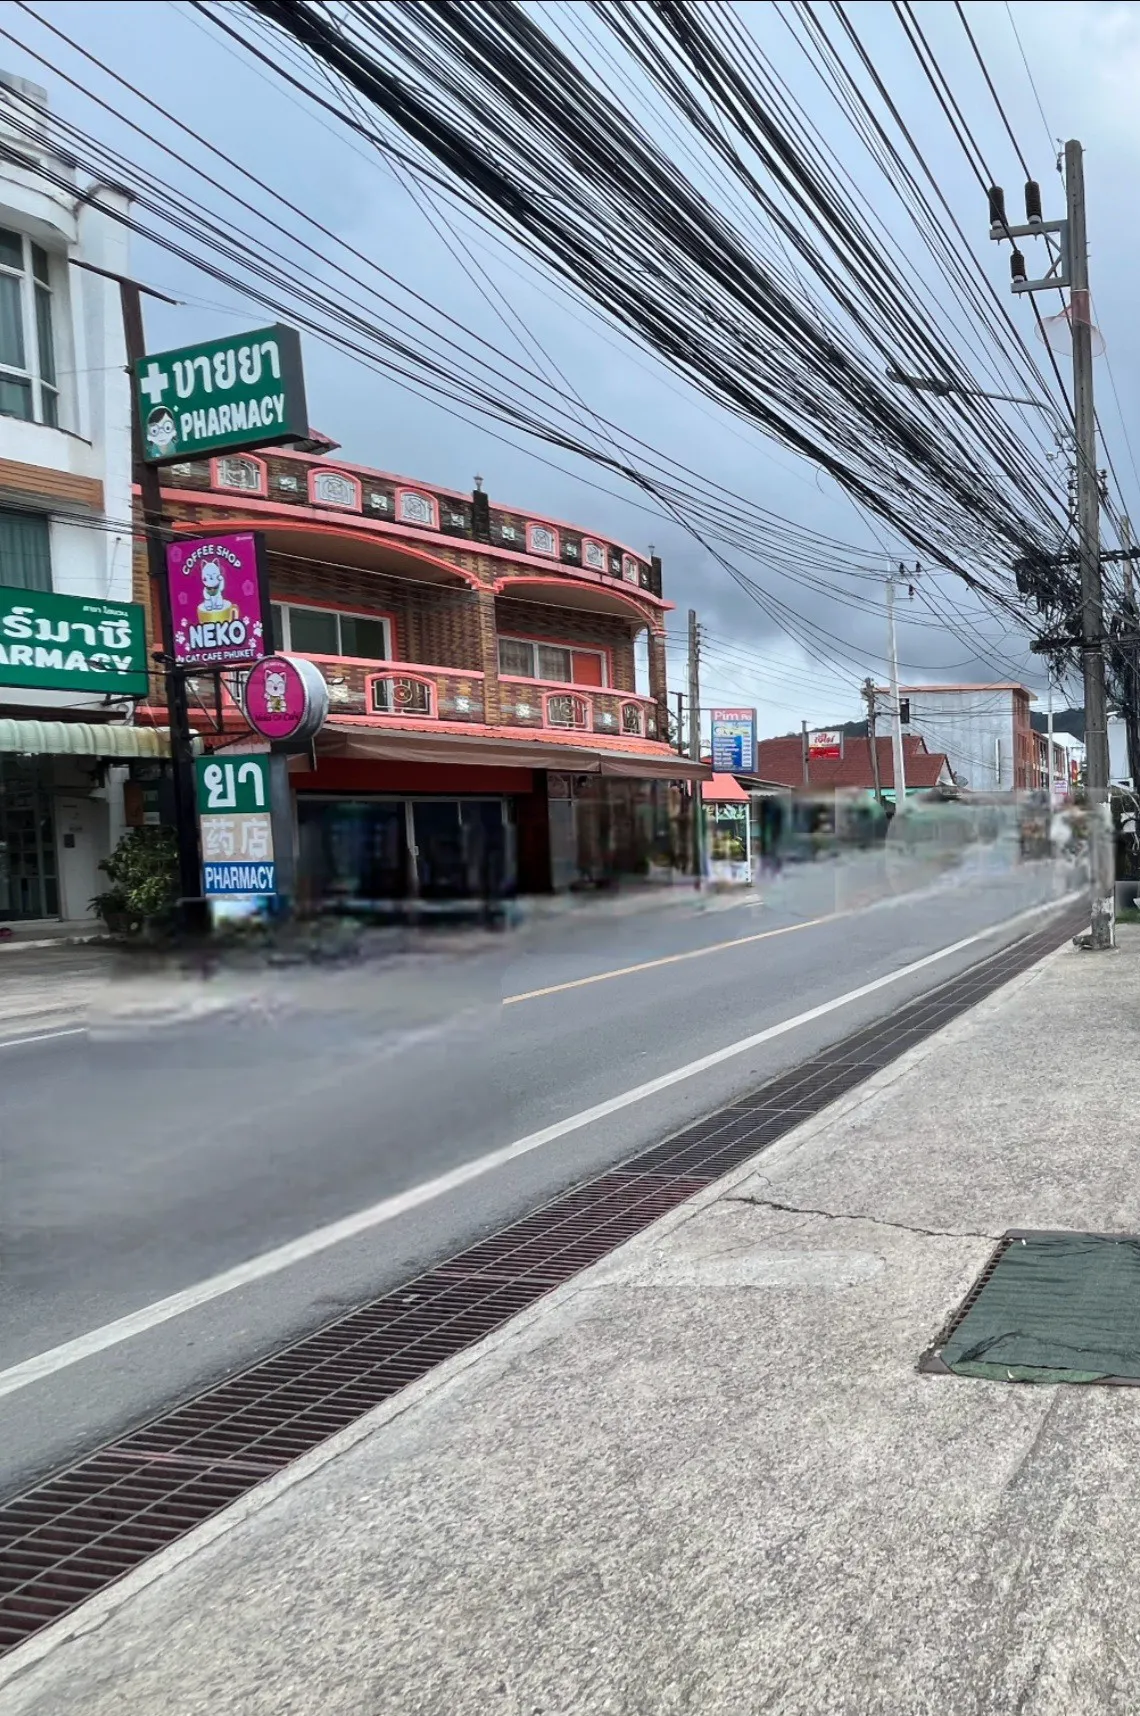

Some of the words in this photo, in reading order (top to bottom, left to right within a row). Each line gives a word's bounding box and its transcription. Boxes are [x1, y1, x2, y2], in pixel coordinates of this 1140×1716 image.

[180, 393, 285, 442] PHARMACY
[182, 544, 215, 575] COFFEE
[216, 545, 242, 568] SHOP
[190, 620, 245, 649] NEKO
[186, 653, 200, 663] CAT
[202, 650, 222, 662] CAFE
[224, 648, 255, 660] PHUKET
[715, 711, 738, 720] Pim
[204, 762, 265, 808] ยา
[203, 817, 268, 860] 药店
[205, 866, 274, 890] PHARMACY
